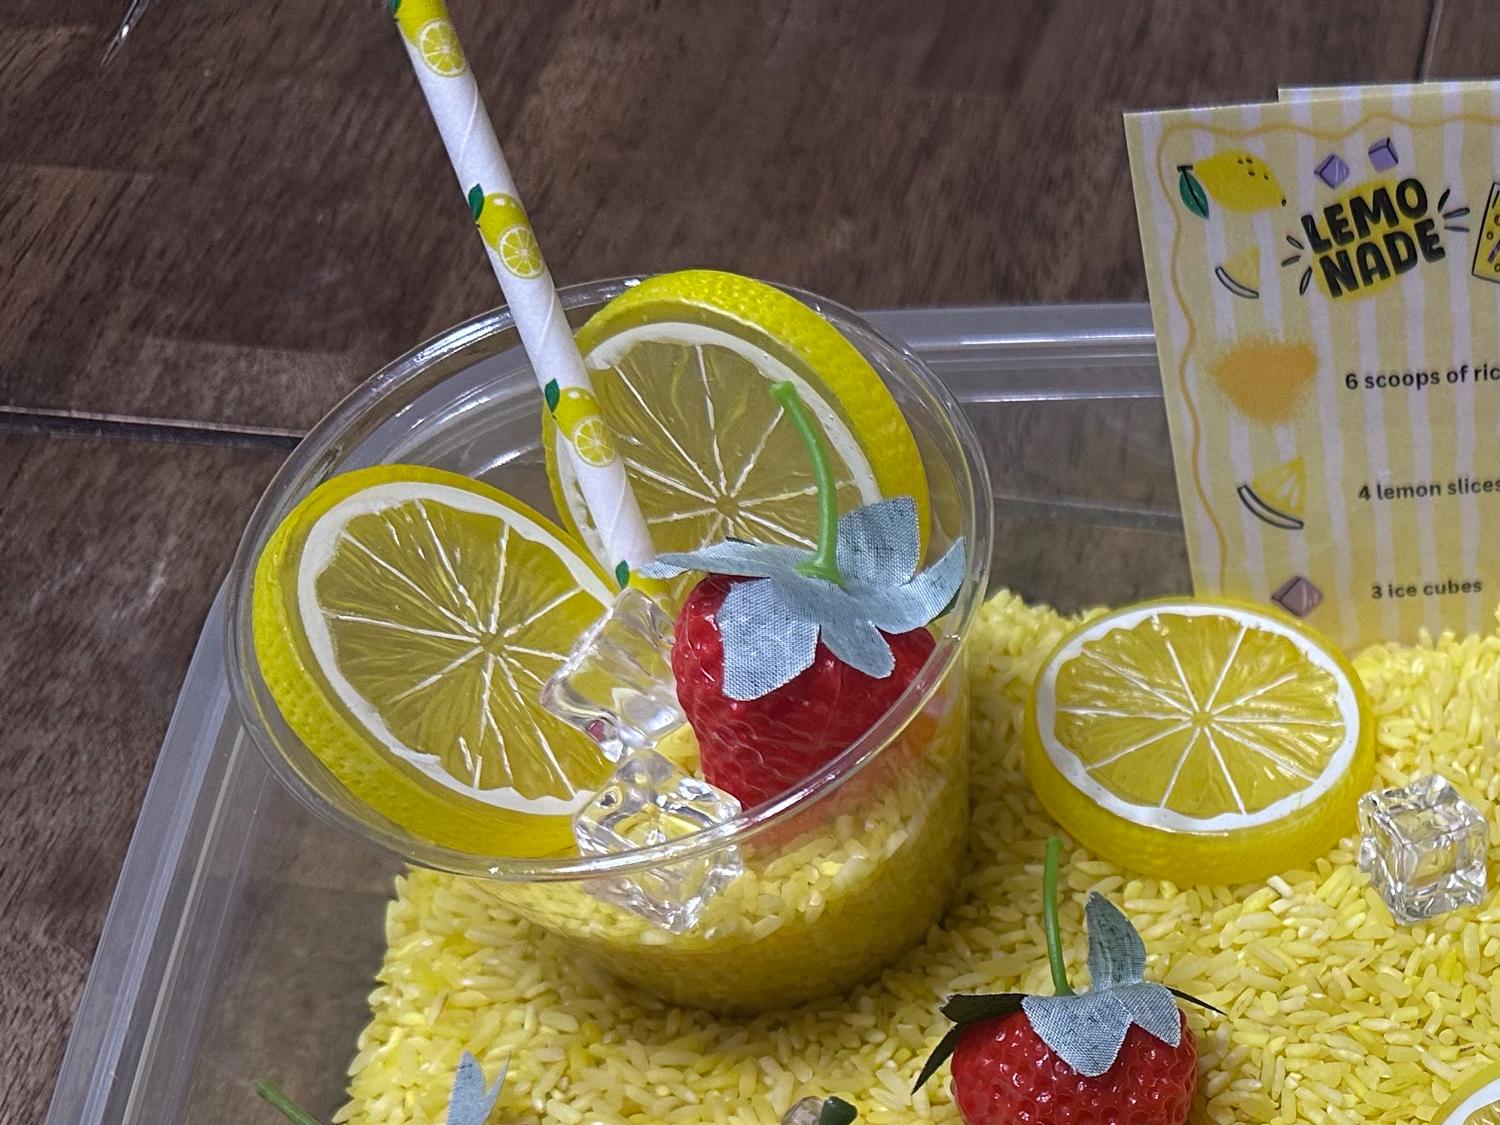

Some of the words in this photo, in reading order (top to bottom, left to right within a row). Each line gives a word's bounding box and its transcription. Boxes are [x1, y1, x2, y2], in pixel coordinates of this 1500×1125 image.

[1301, 178, 1428, 254] LEMO
[1319, 218, 1446, 298] NADE
[1345, 372, 1359, 391] 6
[1364, 368, 1441, 393] scoops
[1446, 365, 1470, 386] of
[1358, 484, 1371, 501] 4
[1376, 480, 1442, 501] lemon
[1371, 583, 1383, 600] 3
[1387, 580, 1418, 599] ice
[1423, 577, 1483, 597] cubes
